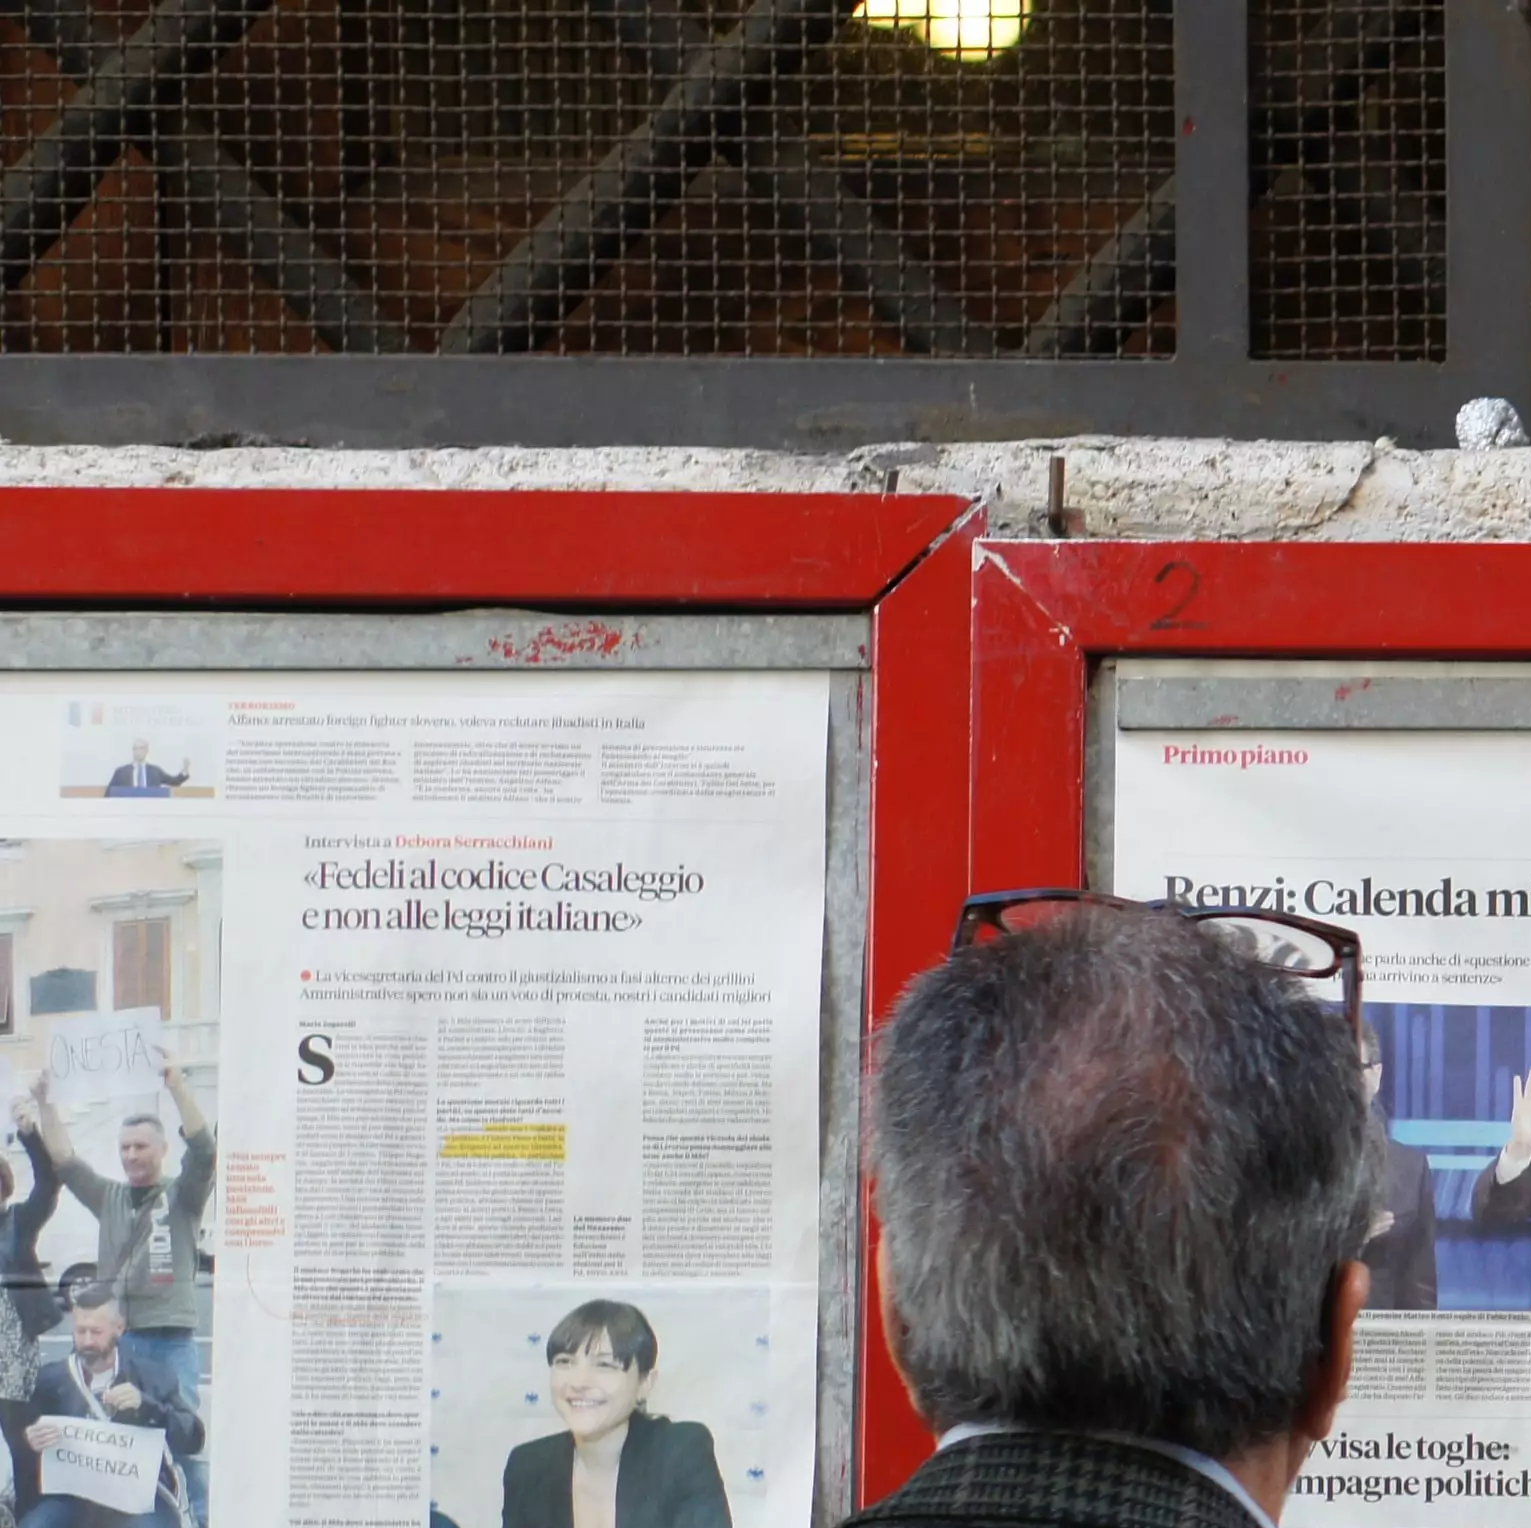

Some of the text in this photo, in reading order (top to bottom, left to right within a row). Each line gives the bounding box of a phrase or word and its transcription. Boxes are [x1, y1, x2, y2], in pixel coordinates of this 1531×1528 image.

[1150, 561, 1208, 630] 2
[1164, 743, 1309, 770] Primo piano
[305, 834, 553, 851] Intervista a Debora Serracchiani
[304, 858, 704, 900] «Fedeli al codice Casaleggio
[1304, 874, 1480, 919] Calenda
[301, 899, 643, 938] e non alle leggi italiane»
[63, 1425, 134, 1447] CERCASI
[1310, 1432, 1510, 1468] visa le toghe:
[56, 1449, 139, 1479] COERENZA
[1294, 1473, 1421, 1502] mpagne
